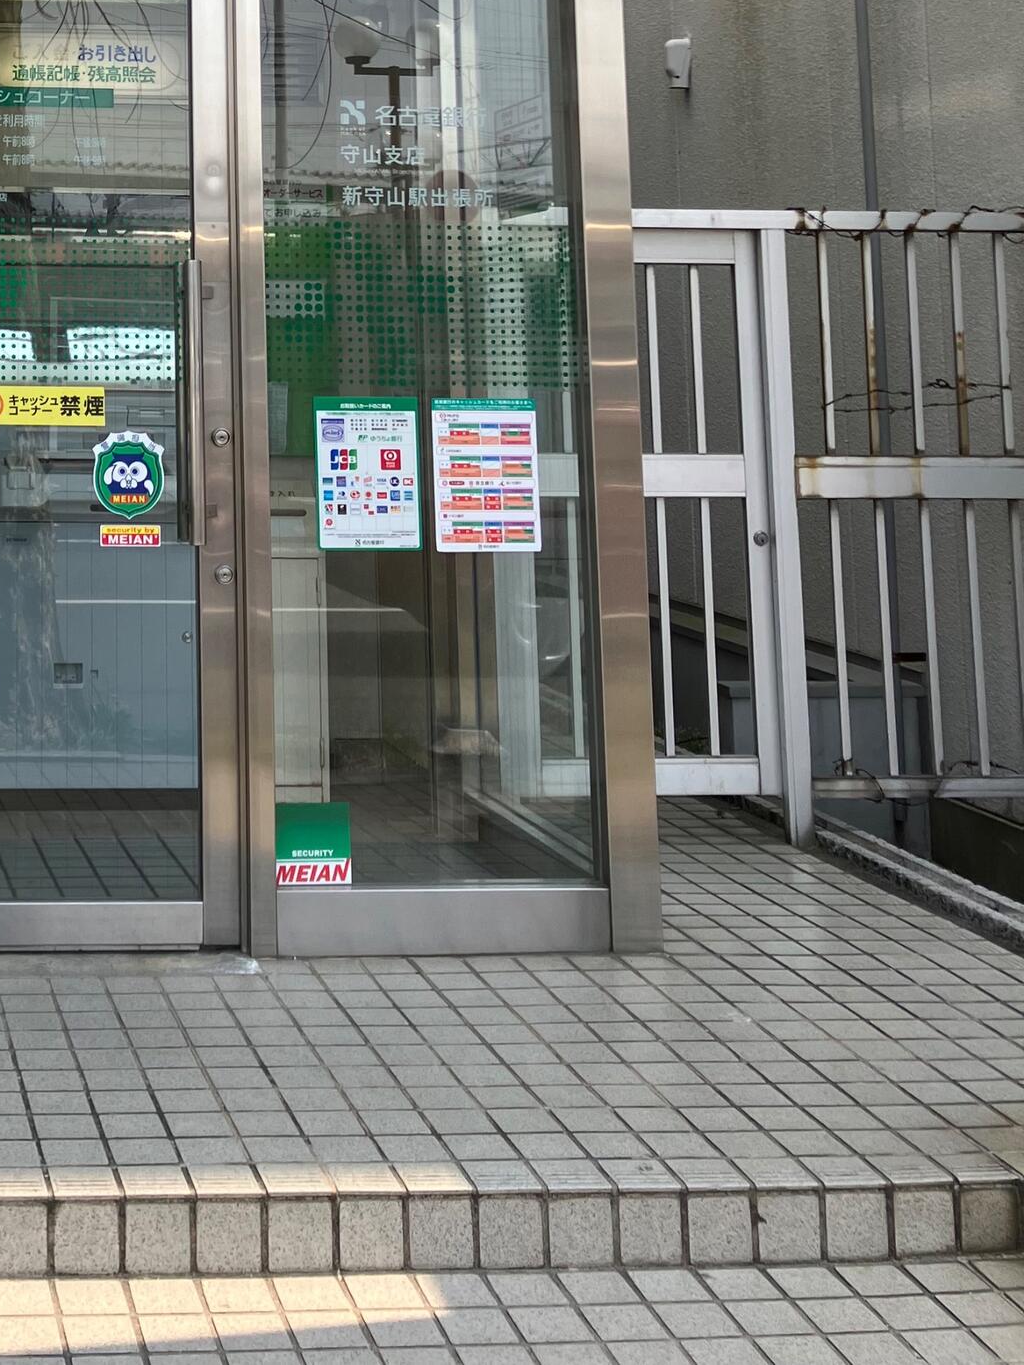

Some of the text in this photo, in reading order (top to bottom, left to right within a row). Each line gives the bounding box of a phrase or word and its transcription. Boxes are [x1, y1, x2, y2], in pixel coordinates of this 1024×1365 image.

[375, 105, 488, 128] 名古屋銀行
[339, 145, 426, 166] 守山支店
[342, 186, 494, 208] 新守山駅出張所
[8, 395, 104, 417] キャッシュ 禁煙
[8, 406, 53, 417] コーナー
[112, 494, 146, 504] MEIAN
[106, 527, 155, 535] security by
[291, 849, 334, 858] SECURITY
[276, 860, 351, 885] MEIAN
